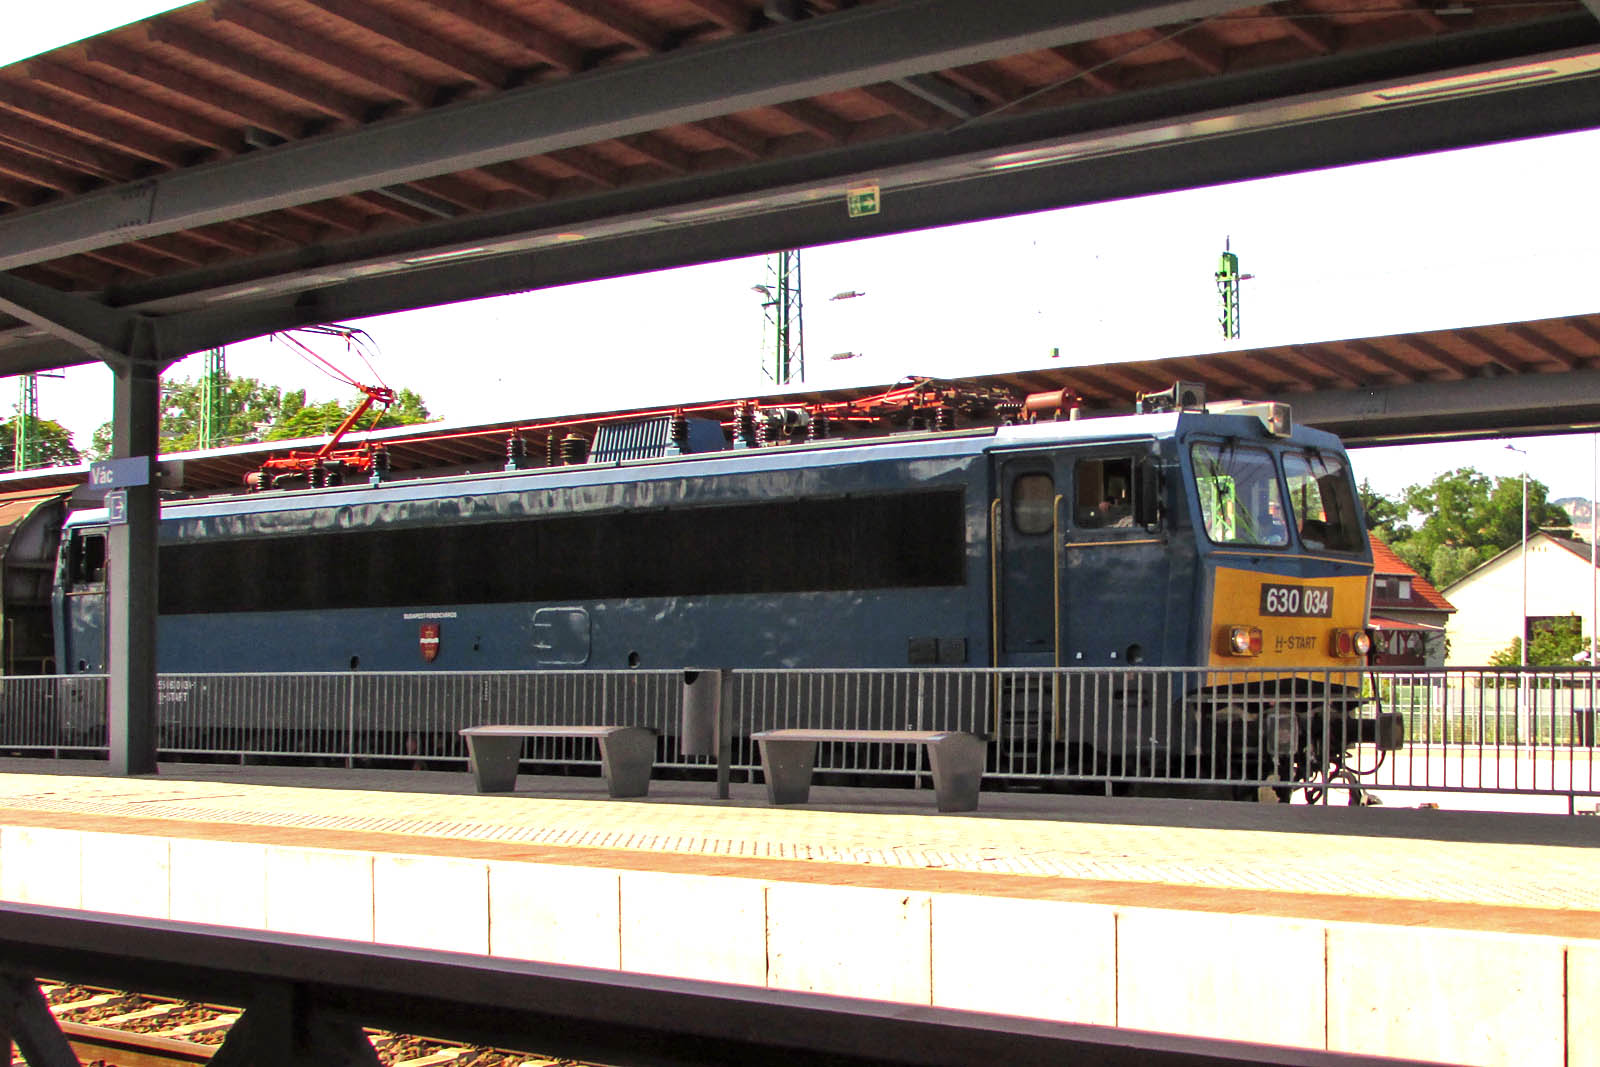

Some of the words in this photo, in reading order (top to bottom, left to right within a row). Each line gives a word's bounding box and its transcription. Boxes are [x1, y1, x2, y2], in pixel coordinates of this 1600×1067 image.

[91, 466, 114, 485] Vác
[1266, 587, 1300, 614] 630
[1303, 590, 1329, 615] 034
[1275, 635, 1317, 651] H-START
